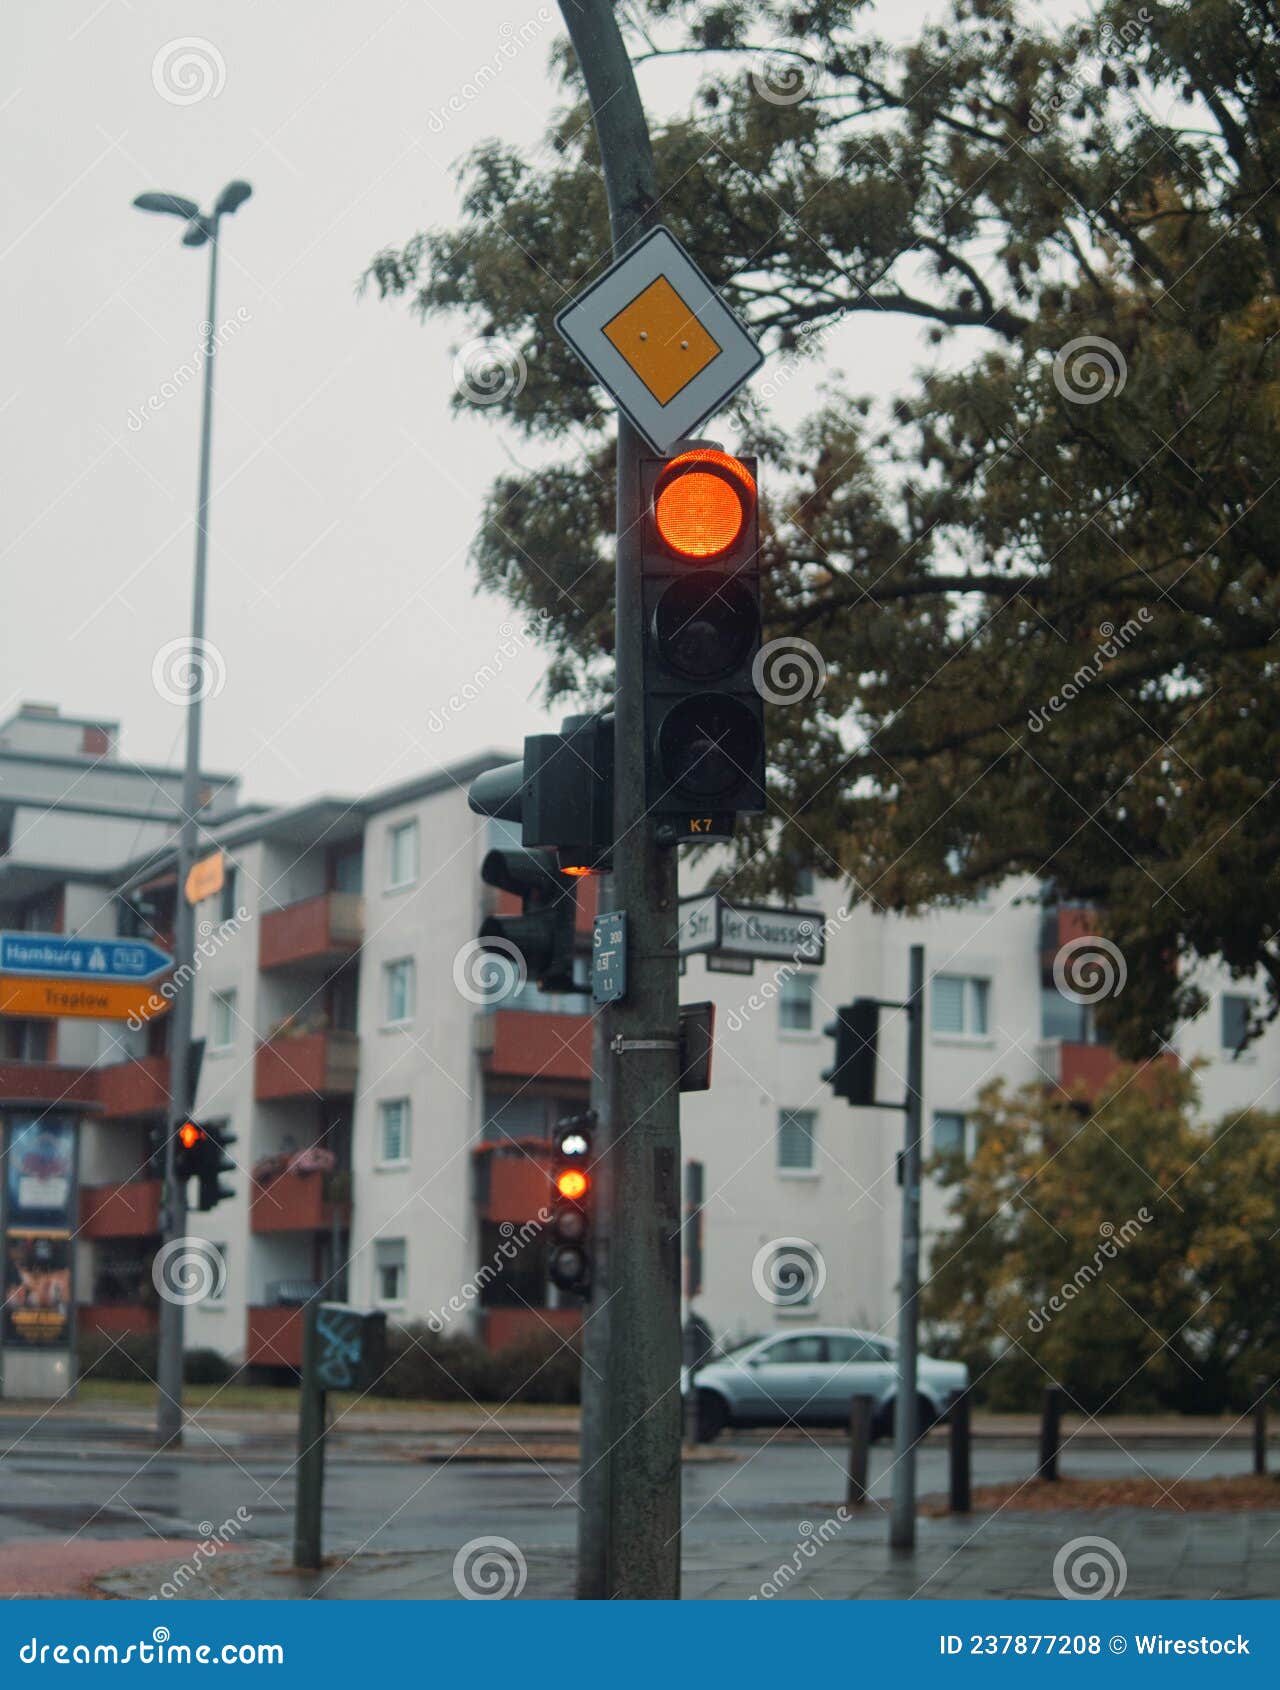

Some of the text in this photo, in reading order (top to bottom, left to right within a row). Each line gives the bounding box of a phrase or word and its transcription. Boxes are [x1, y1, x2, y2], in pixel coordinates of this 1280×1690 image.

[689, 817, 713, 833] K7
[746, 915, 818, 945] Chauss
[6, 943, 82, 970] Hamburg
